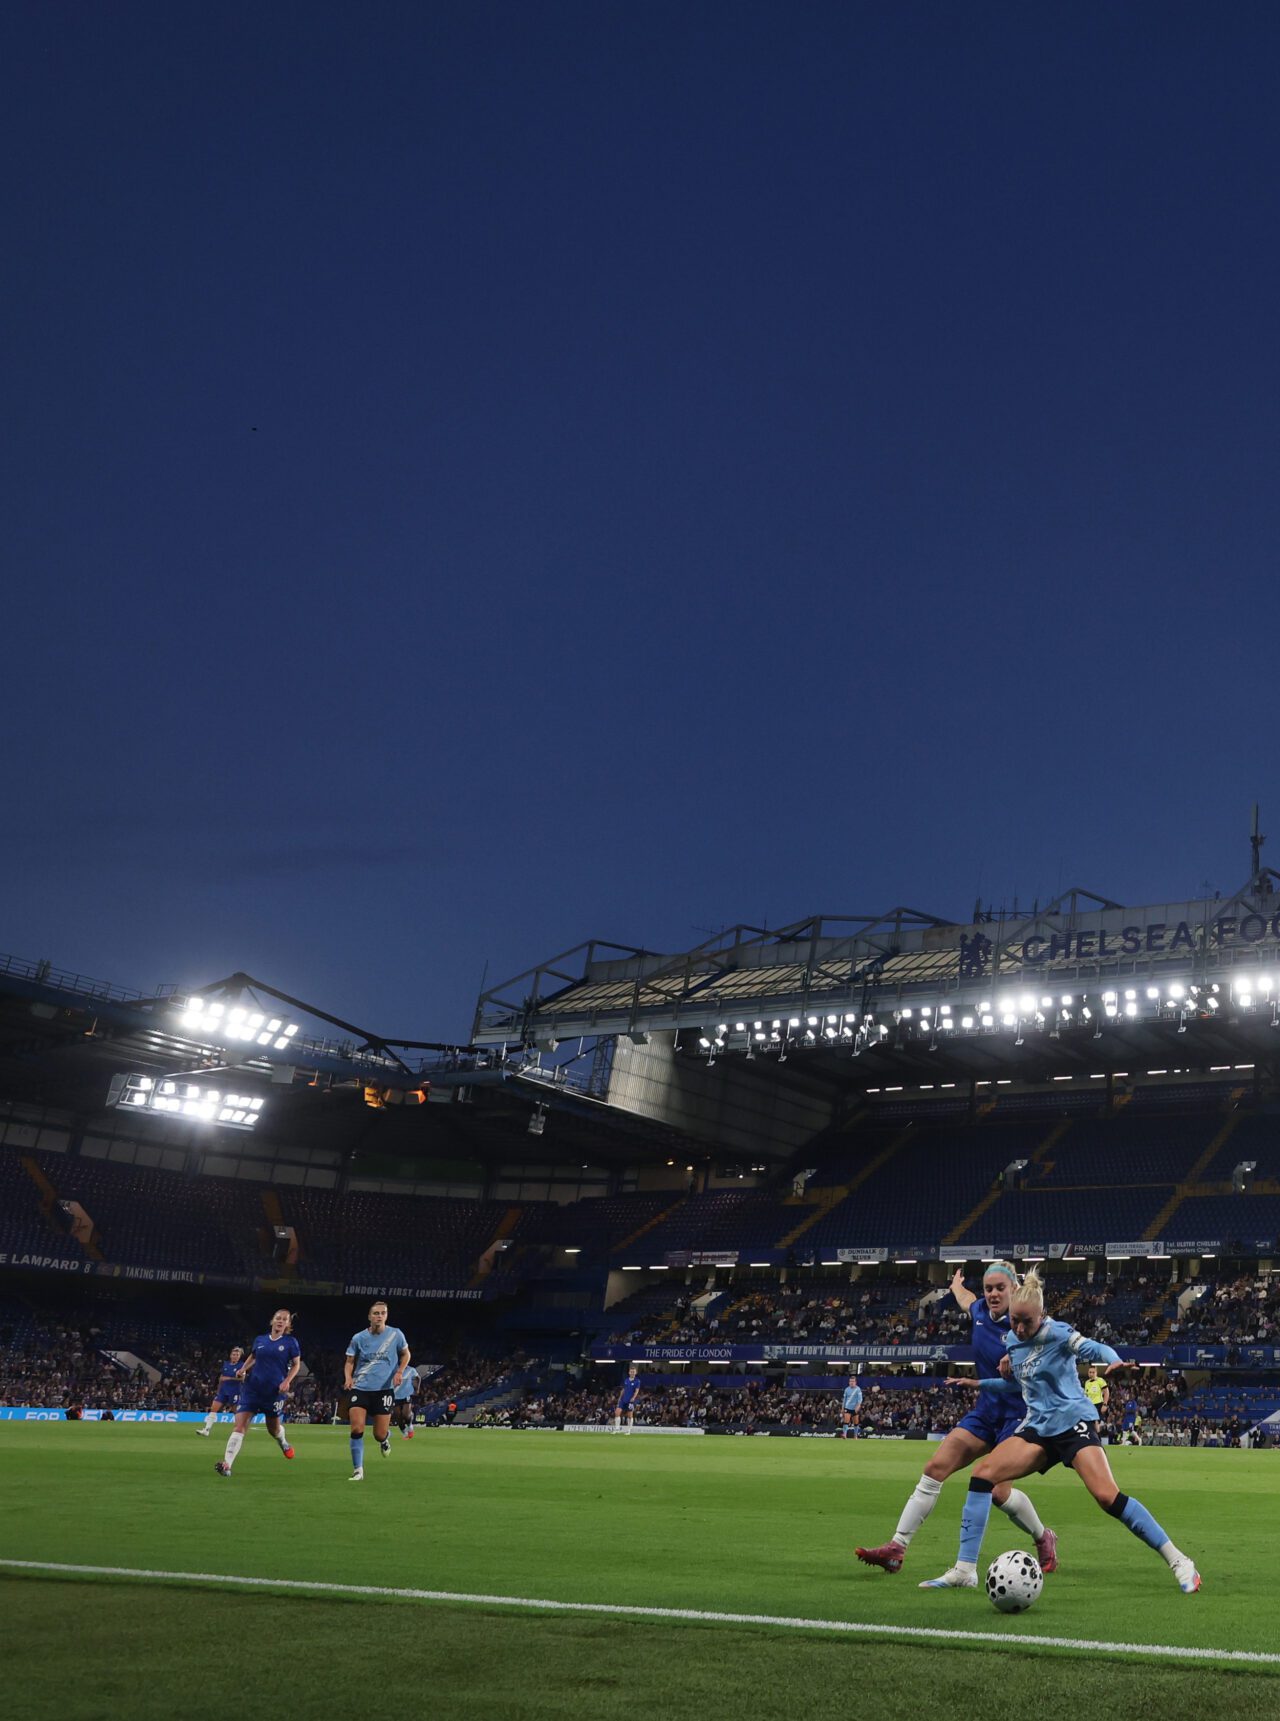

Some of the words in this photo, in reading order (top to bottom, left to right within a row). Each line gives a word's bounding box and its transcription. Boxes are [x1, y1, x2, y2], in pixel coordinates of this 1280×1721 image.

[1022, 921, 1196, 963] CHELSEA
[1074, 1244, 1104, 1252] FRANCE
[11, 1253, 80, 1271] LAMPARD
[84, 1263, 92, 1274] 8
[125, 1266, 154, 1280] TAKING
[156, 1268, 169, 1281] THE
[171, 1269, 194, 1283] MIKEL
[345, 1285, 387, 1296] LONDON'S
[415, 1289, 454, 1298] LONDON'S
[455, 1290, 483, 1299] FINEST
[644, 1348, 660, 1357] THE
[661, 1348, 684, 1357] PRIDE
[685, 1348, 697, 1357] OF
[698, 1348, 733, 1358] LONDON
[785, 1346, 800, 1355] THEY
[803, 1346, 824, 1355] DON'T
[825, 1346, 845, 1356] MAKE
[846, 1346, 865, 1356] THEM
[866, 1346, 881, 1356] LIKE
[897, 1346, 932, 1356] ANYMORE
[382, 1395, 393, 1407] 10
[25, 1411, 60, 1421] FOR
